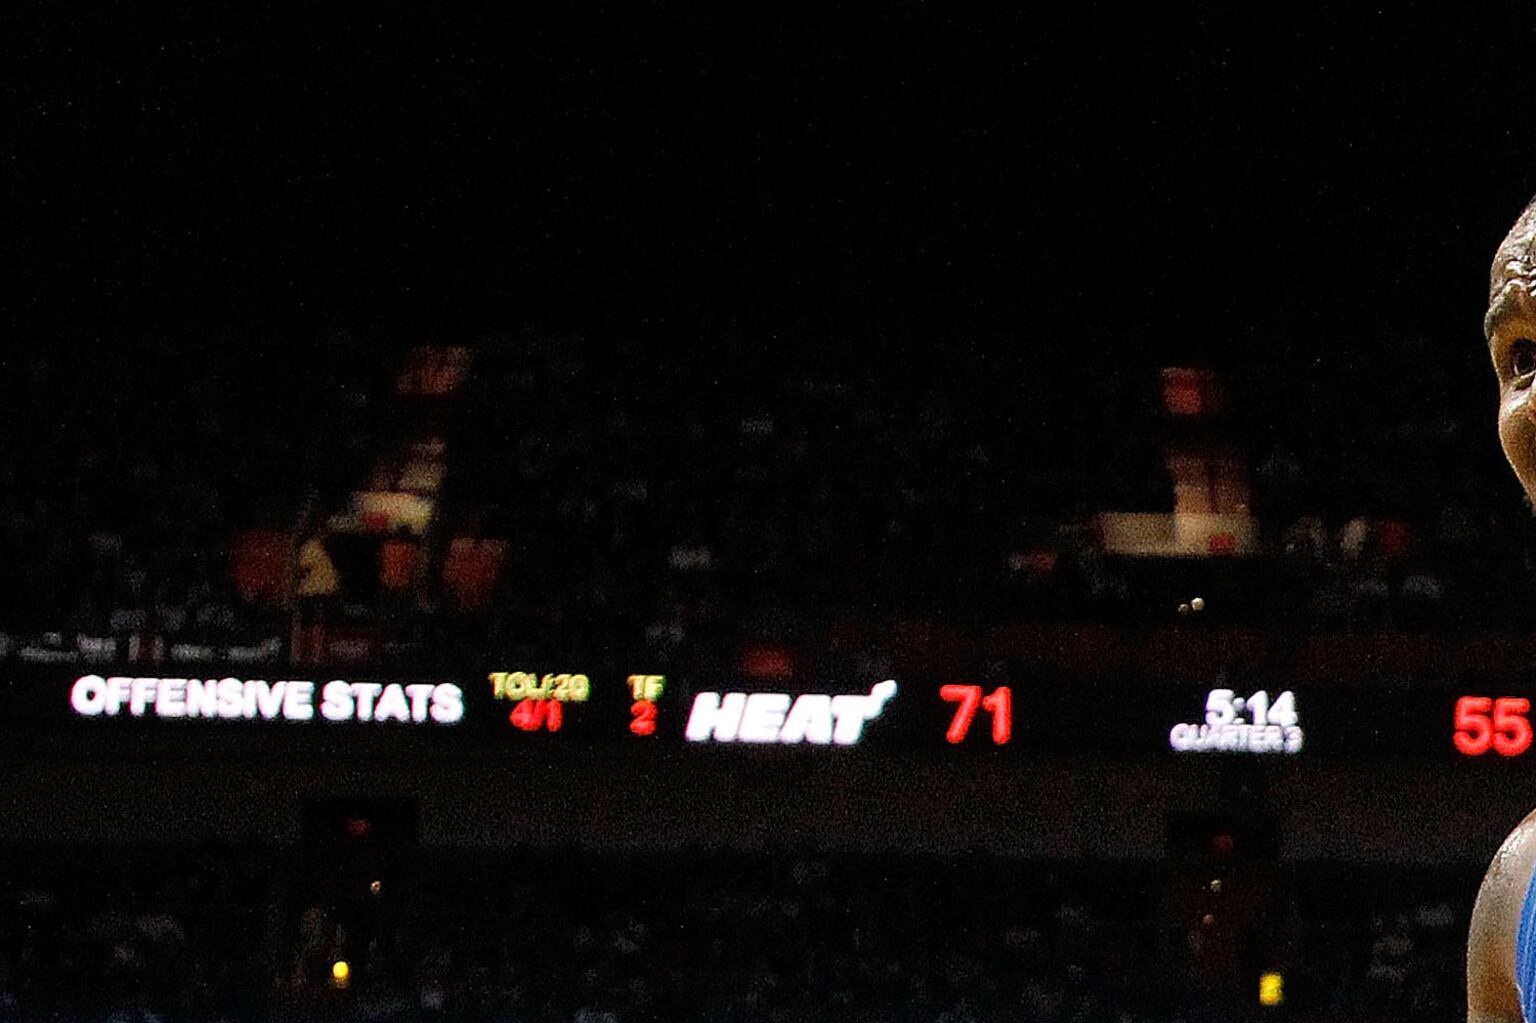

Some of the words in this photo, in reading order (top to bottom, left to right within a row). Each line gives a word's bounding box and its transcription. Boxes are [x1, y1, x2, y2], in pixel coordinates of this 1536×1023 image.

[70, 675, 314, 719] OFFENSIVE
[319, 680, 464, 723] STATS
[629, 700, 657, 735] 2
[684, 680, 897, 745] HEAT
[940, 684, 1012, 744] 71
[1205, 688, 1298, 727] 5:14
[1452, 696, 1534, 757] 55
